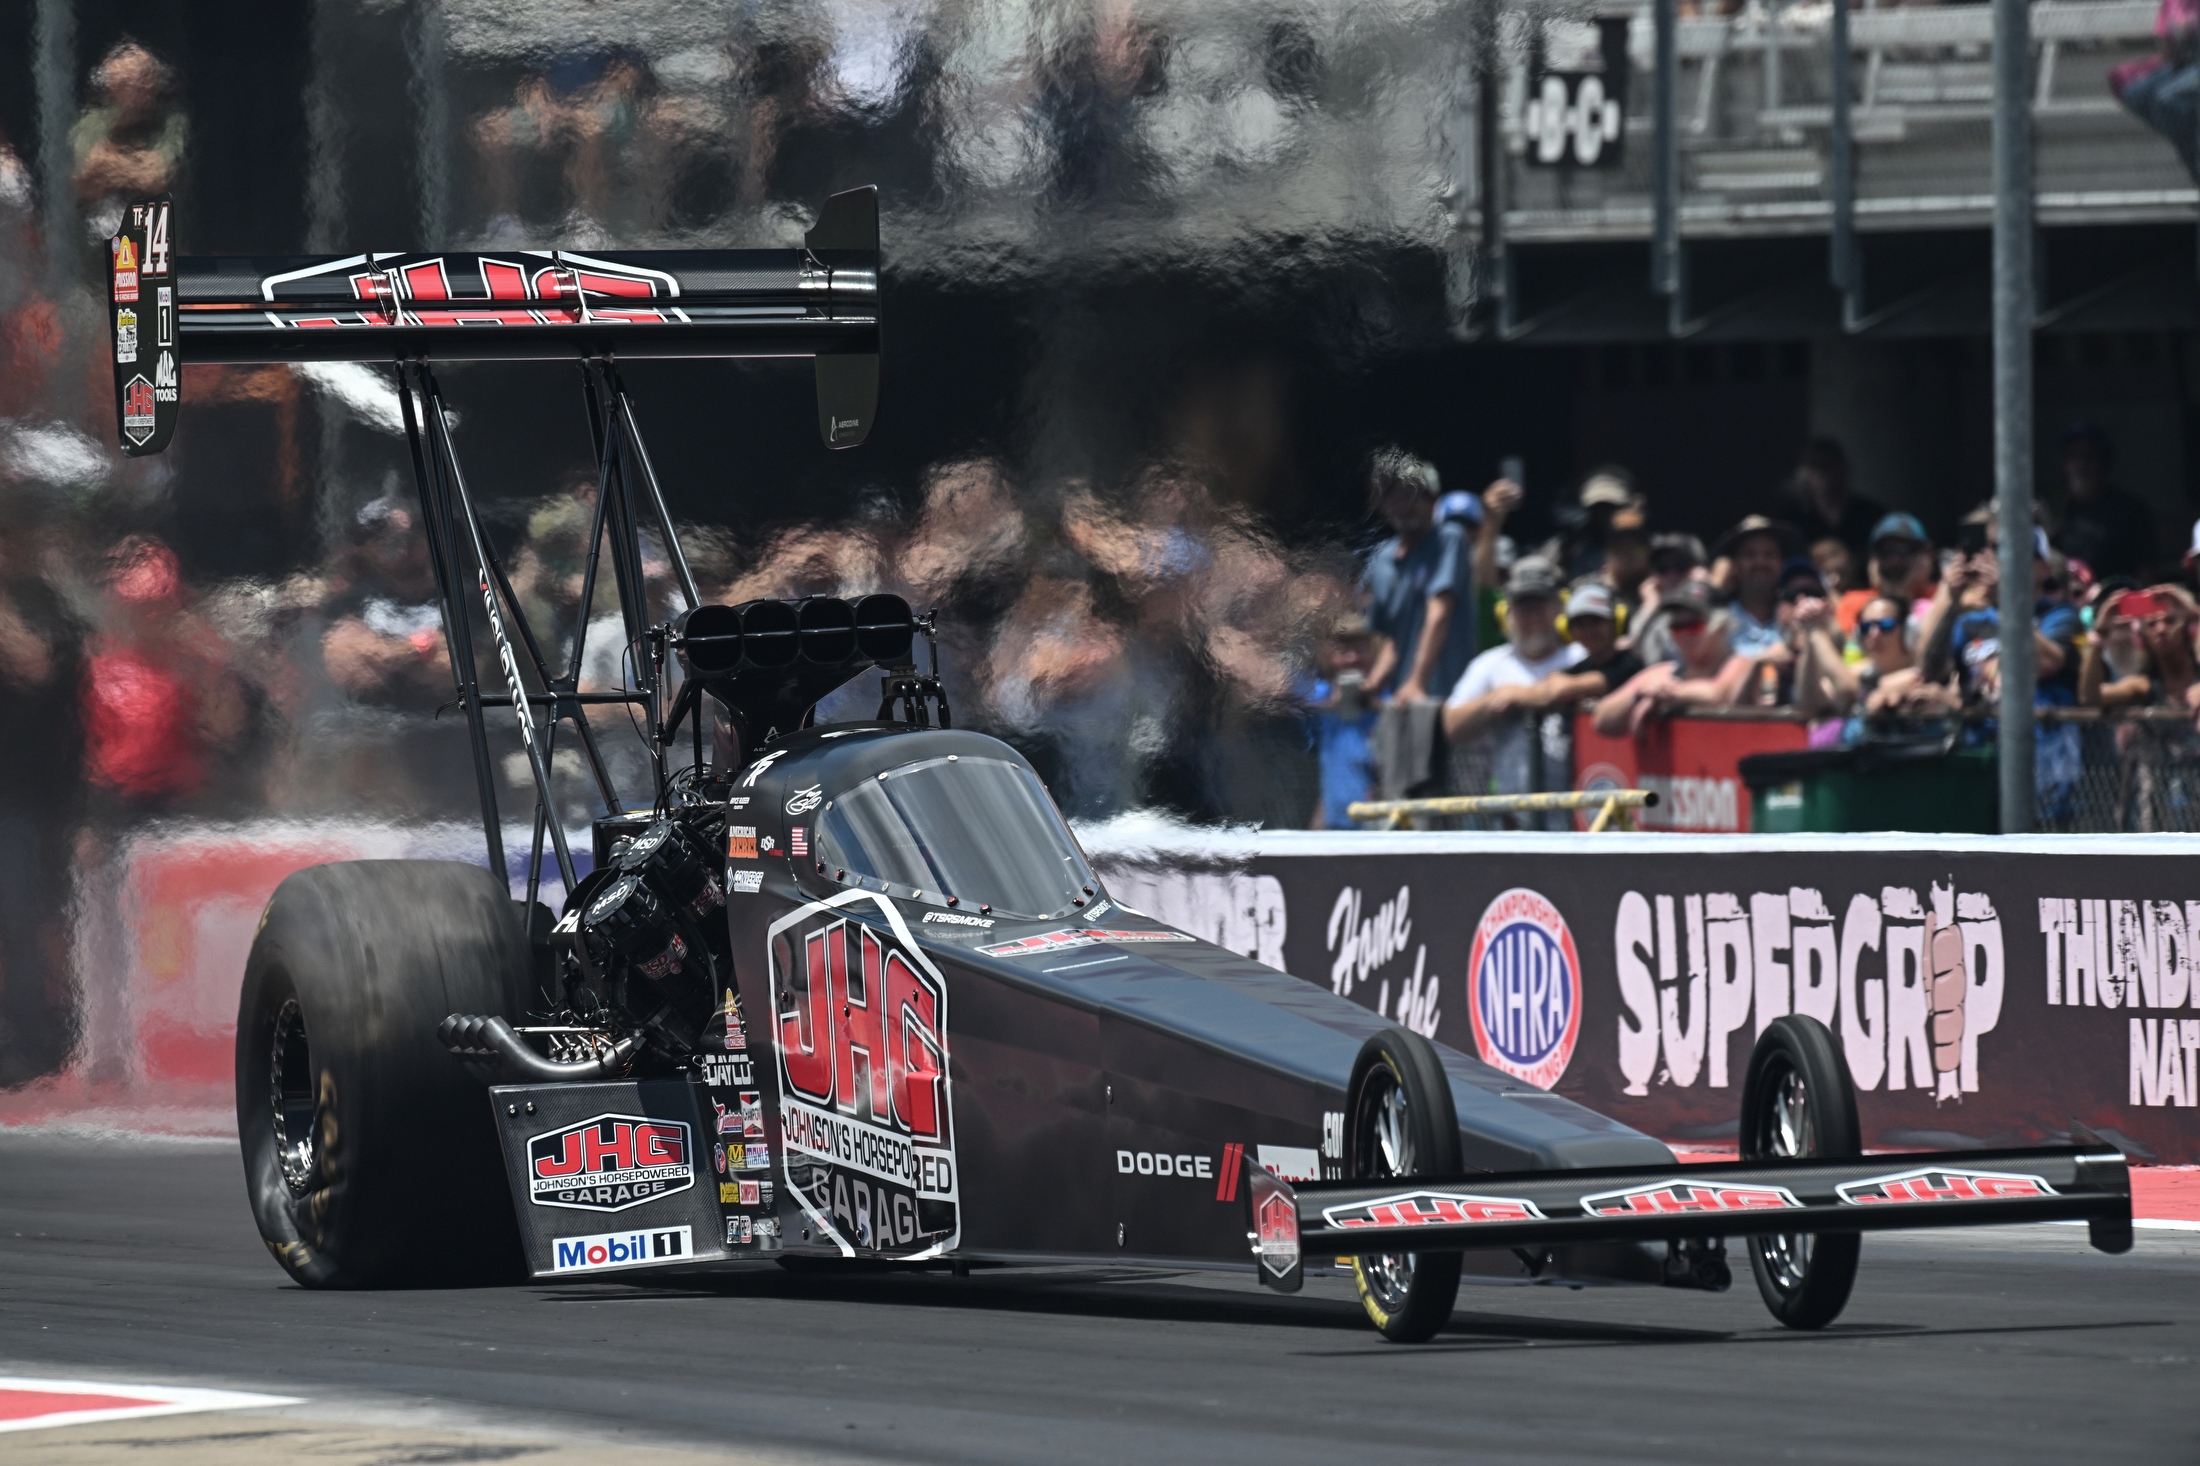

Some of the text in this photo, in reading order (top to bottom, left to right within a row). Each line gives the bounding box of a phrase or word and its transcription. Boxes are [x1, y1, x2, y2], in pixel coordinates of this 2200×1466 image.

[133, 206, 144, 227] TF
[142, 203, 169, 276] 14
[161, 307, 168, 340] 1
[156, 351, 177, 388] MAC
[125, 380, 154, 416] JHG
[156, 388, 177, 402] TOOLS
[631, 837, 659, 851] MSD
[729, 826, 757, 838] AMERICAN
[761, 836, 775, 851] DSR
[733, 870, 764, 884] CONVERGE
[592, 884, 628, 915] MSD
[922, 911, 995, 928] @TSRSMOKE
[1484, 892, 1562, 940] CHAMPIONSHIP
[1327, 885, 1411, 996] Home
[1485, 929, 1564, 1057] NHRA
[779, 918, 941, 1143] JHG
[705, 1054, 751, 1086] DAYCO
[785, 1105, 851, 1161] JOHNSON'S
[534, 1122, 684, 1178] JHG
[746, 1147, 769, 1166] MAHLE
[1116, 1149, 1214, 1179] DODGE
[534, 1165, 690, 1192] JOHNSON'S HORSEPOWERED
[557, 1181, 667, 1204] GARAGE
[741, 1183, 758, 1202] SIMPSON
[1853, 1175, 2041, 1206] JHG
[1338, 1199, 1530, 1229] JHG
[1595, 1187, 1786, 1218] JHG
[1261, 1199, 1296, 1242] JHG
[557, 1232, 672, 1268] Mobil 1
